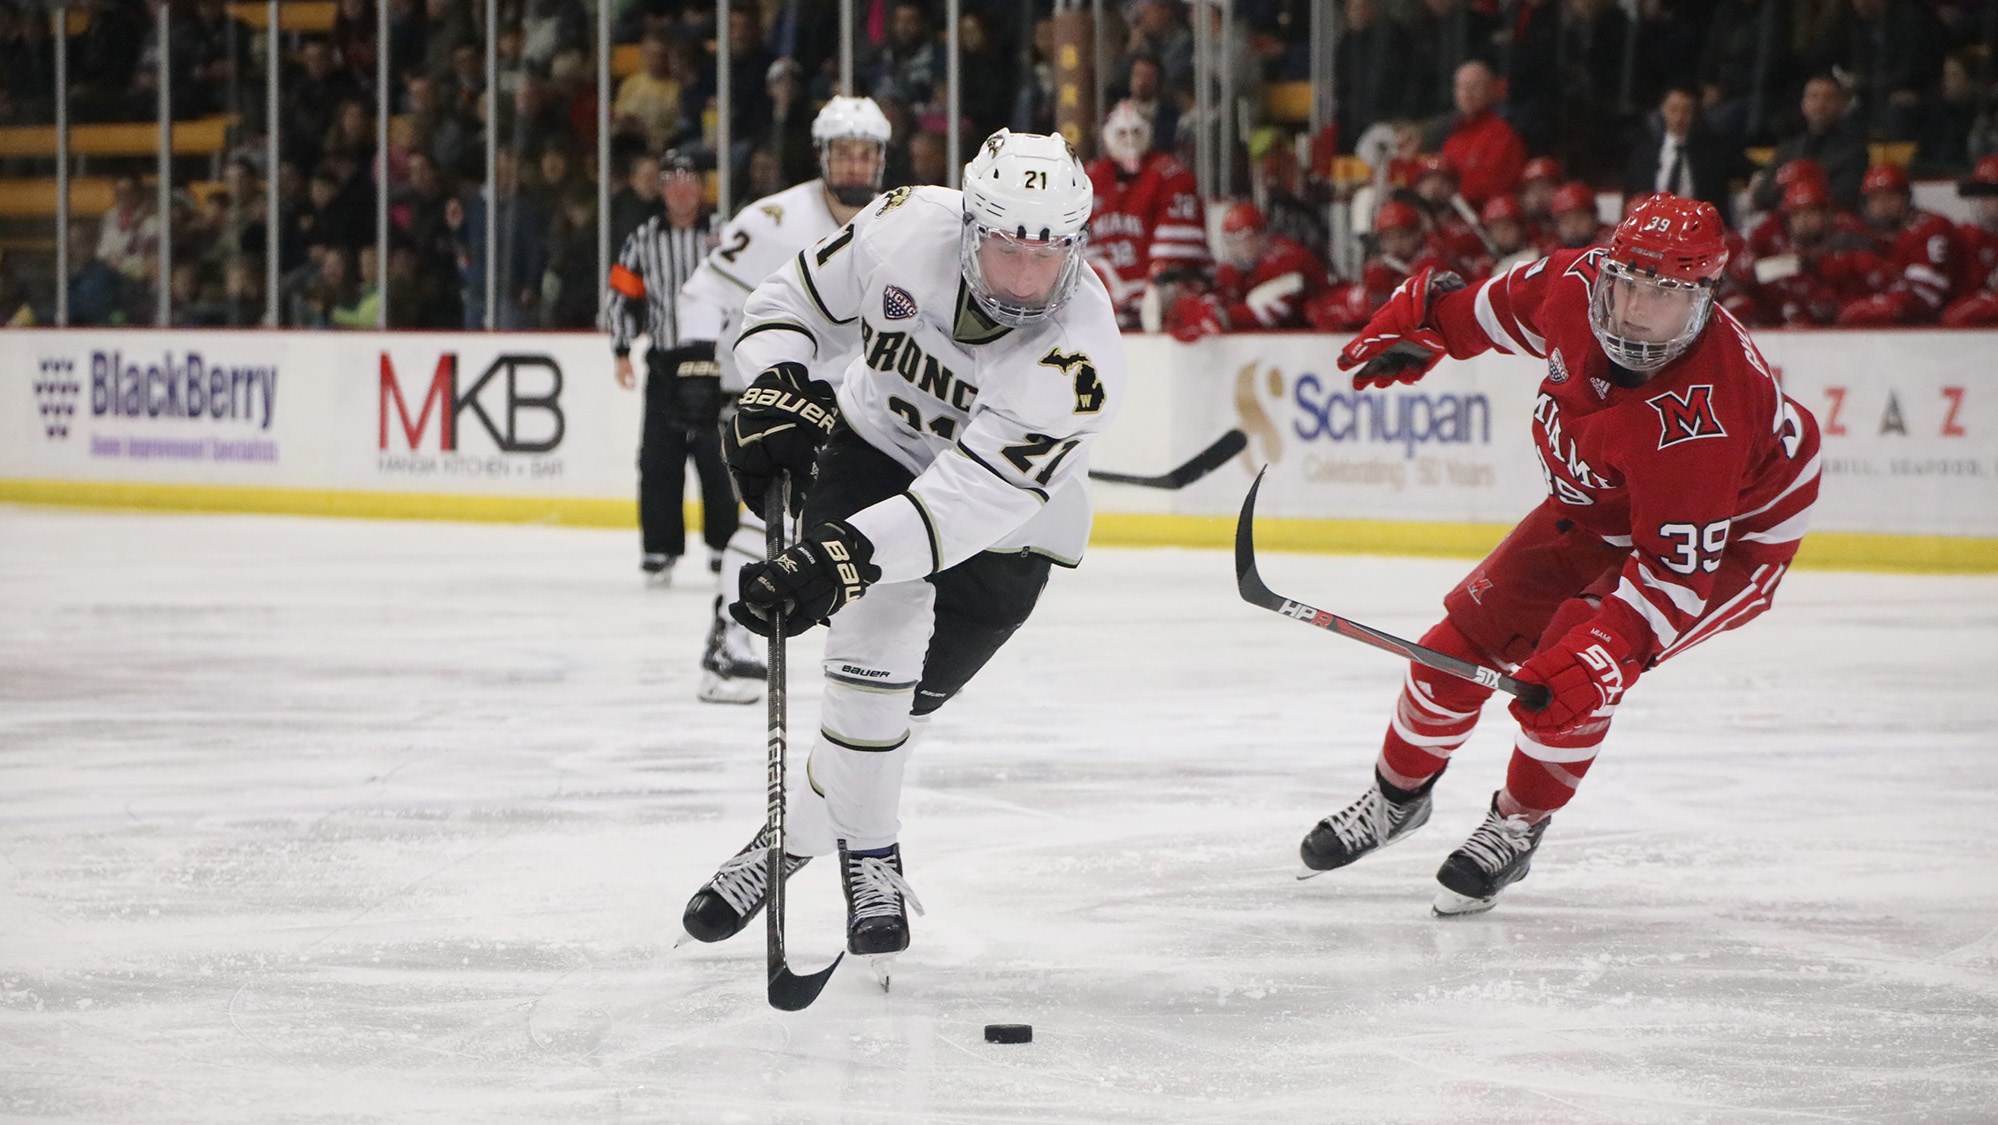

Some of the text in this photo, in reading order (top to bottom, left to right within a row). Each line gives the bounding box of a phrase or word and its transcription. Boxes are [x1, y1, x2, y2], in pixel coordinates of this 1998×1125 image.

[1024, 170, 1047, 190] 21
[1649, 215, 1671, 232] 39
[720, 229, 751, 263] 2
[884, 286, 917, 317] NCHC
[89, 350, 279, 430] BlackBerry
[379, 350, 566, 453] MKB
[738, 386, 837, 435] BAUER
[1078, 394, 1093, 408] W
[1293, 372, 1492, 459] Schupan
[1645, 384, 1728, 450] M
[1001, 432, 1082, 486] 21
[1535, 392, 1617, 489] MIAMI
[1659, 518, 1732, 574] 39
[1278, 600, 1333, 629] HPR
[1589, 627, 1613, 644] MIAMI
[841, 664, 891, 678] BAUER
[1474, 665, 1502, 689] STX
[1576, 644, 1624, 704] STX
